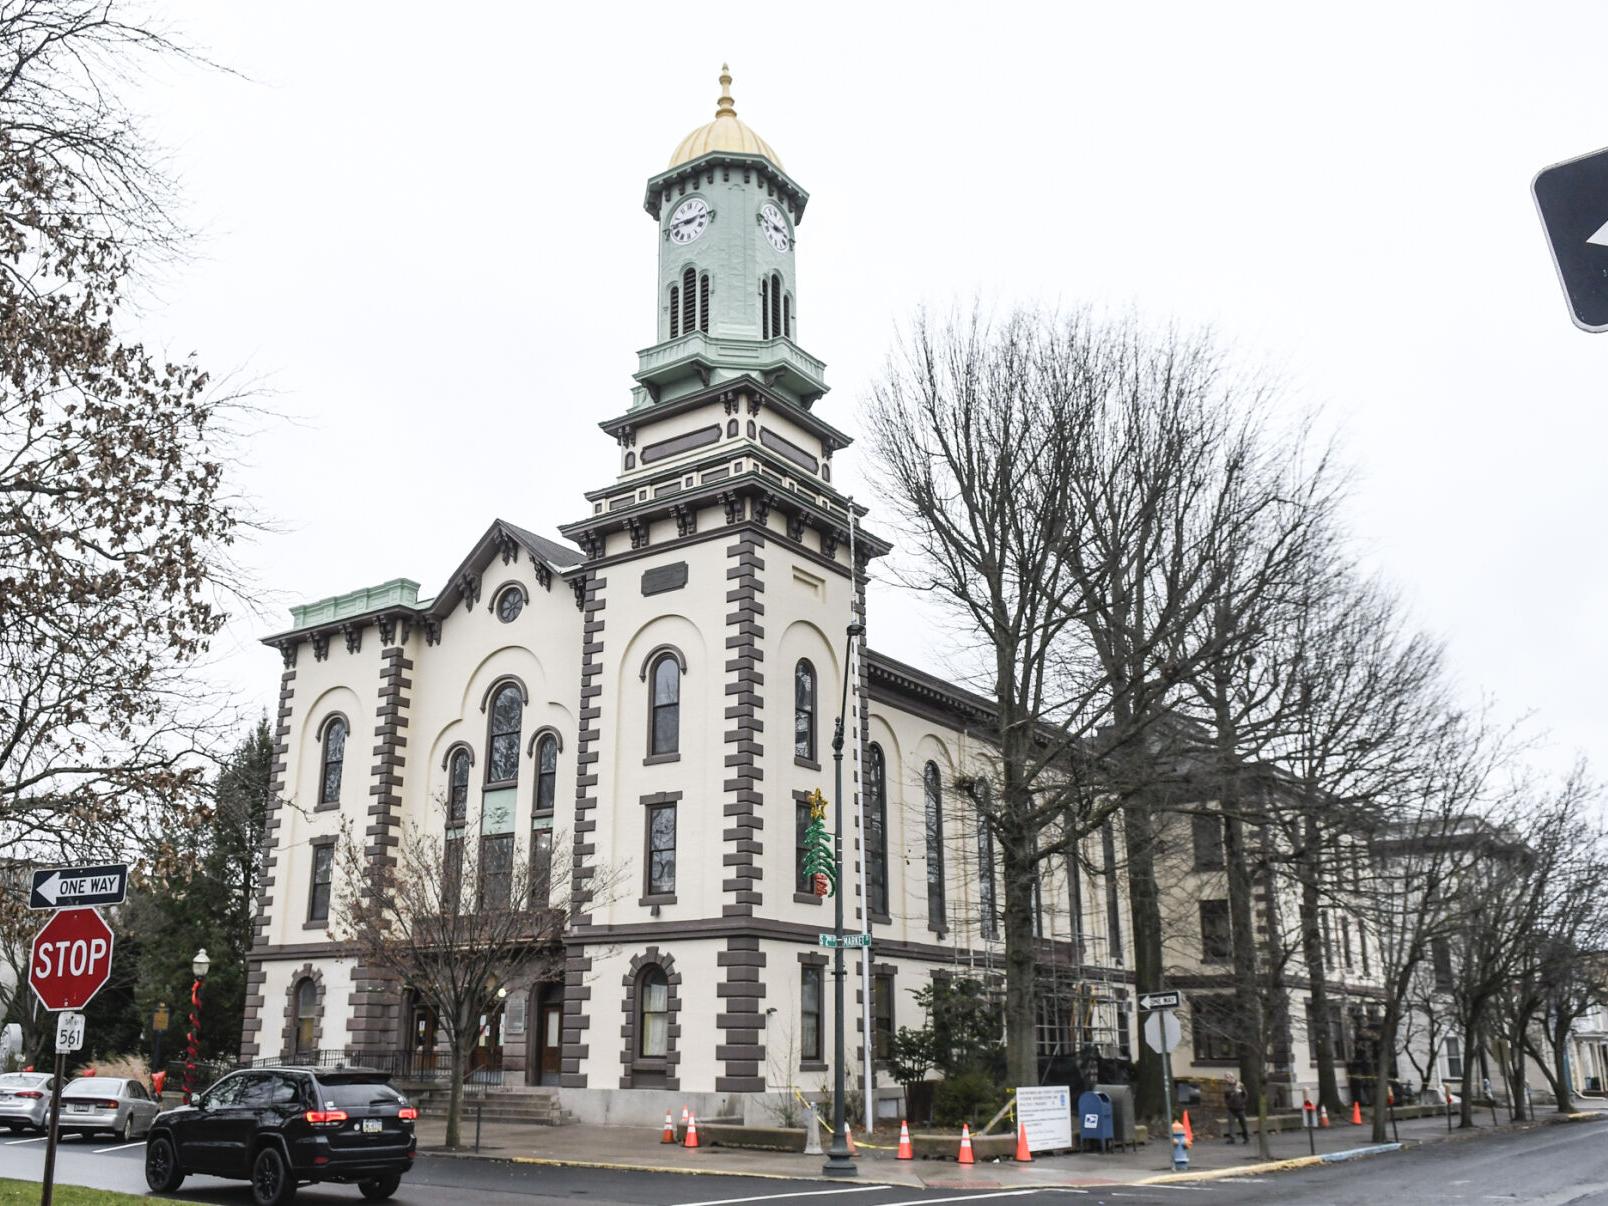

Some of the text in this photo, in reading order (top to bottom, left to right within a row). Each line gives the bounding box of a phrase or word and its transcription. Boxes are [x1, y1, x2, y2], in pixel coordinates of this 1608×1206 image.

[60, 876, 117, 895] ONE WAY
[843, 936, 864, 947] MARKET
[35, 939, 106, 979] STOP
[59, 1029, 81, 1045] 561
